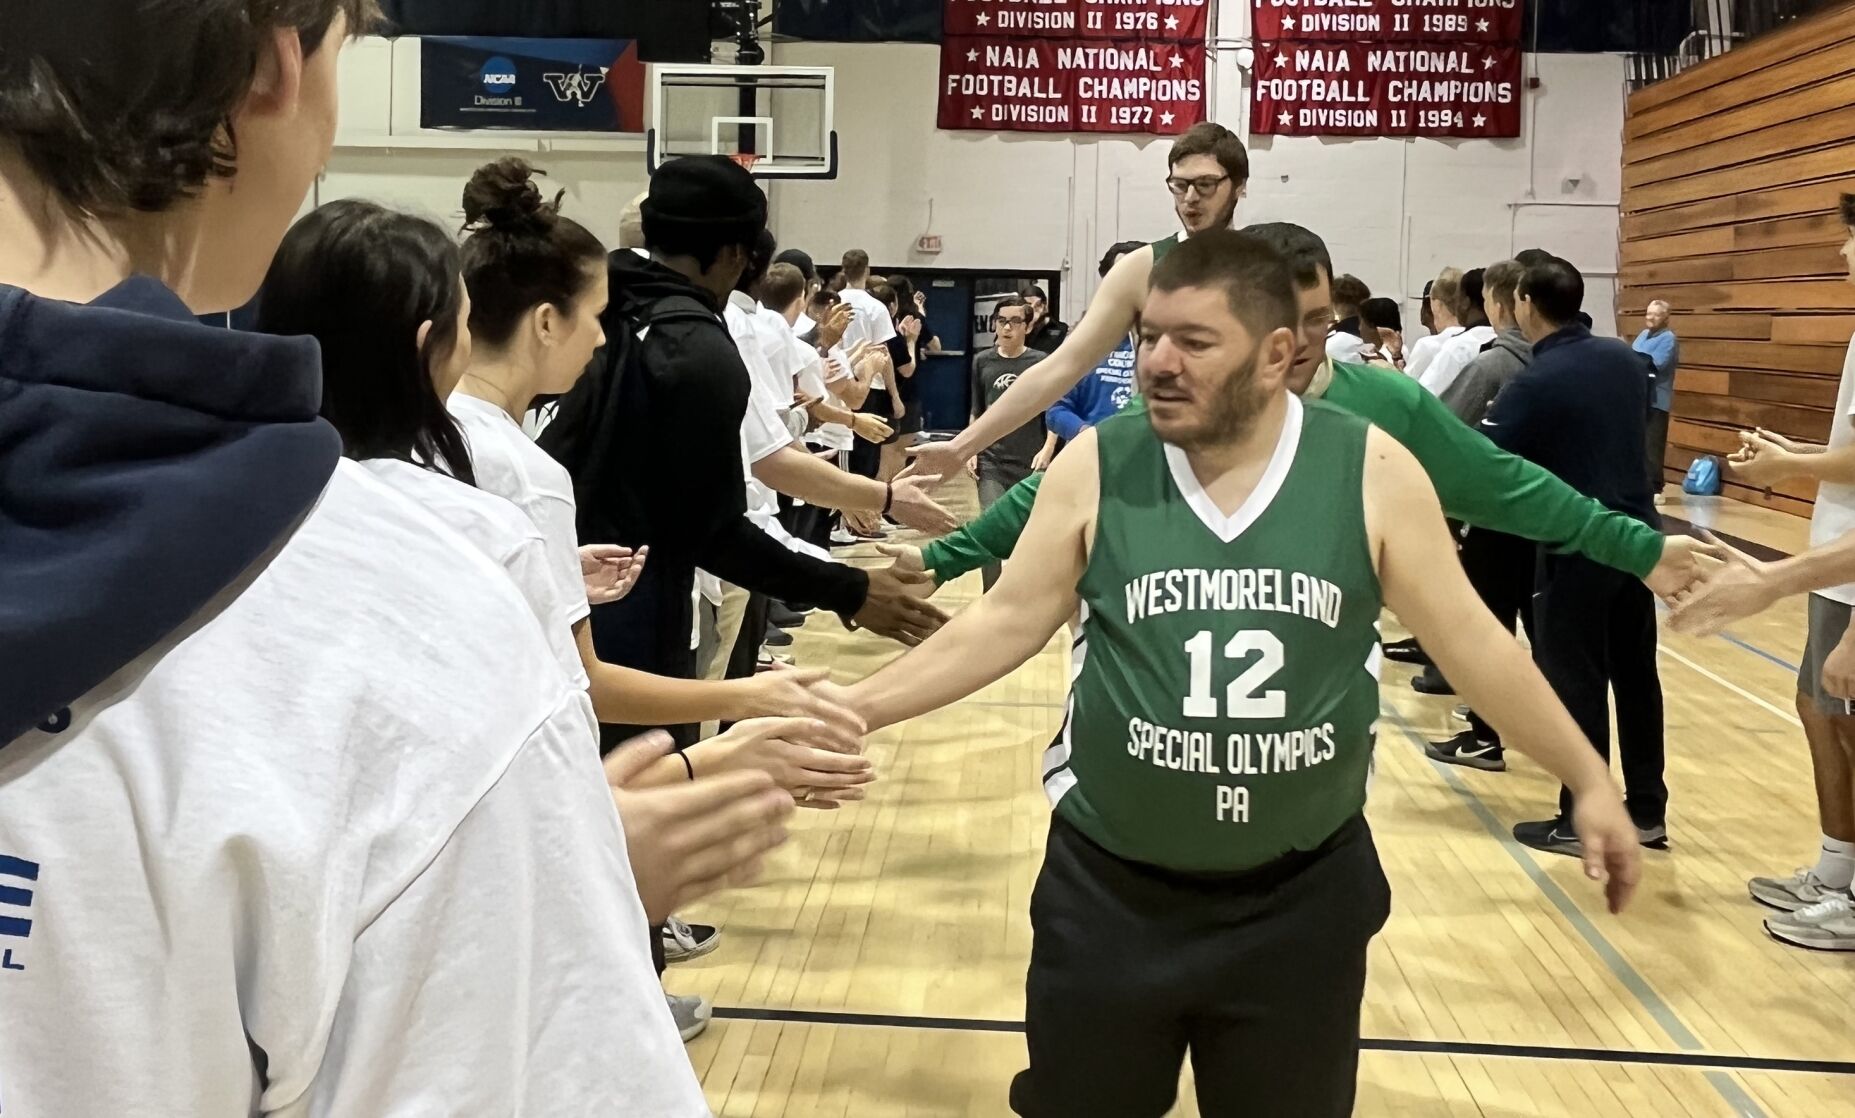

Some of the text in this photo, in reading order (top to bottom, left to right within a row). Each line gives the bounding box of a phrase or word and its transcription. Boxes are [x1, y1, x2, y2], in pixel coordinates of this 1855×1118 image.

[998, 11, 1158, 30] DIVISION II 1976
[1301, 14, 1468, 32] DIVISION II 1989
[985, 46, 1162, 72] NAIA NATIONAL
[1295, 50, 1475, 74] NAIA NATIONAL
[947, 74, 1201, 101] FOOTBALL CHAMPIONS
[1256, 79, 1512, 103] FOOTBALL CHAMPIONS
[991, 104, 1153, 125] DIVISION II 1977
[1299, 109, 1464, 128] DIVISION II 1994
[1125, 568, 1342, 629] WESTMORELAND
[1183, 629, 1286, 719] 12
[1127, 716, 1335, 774] SPECIAL OLYMPICS
[1216, 785, 1249, 823] PA
